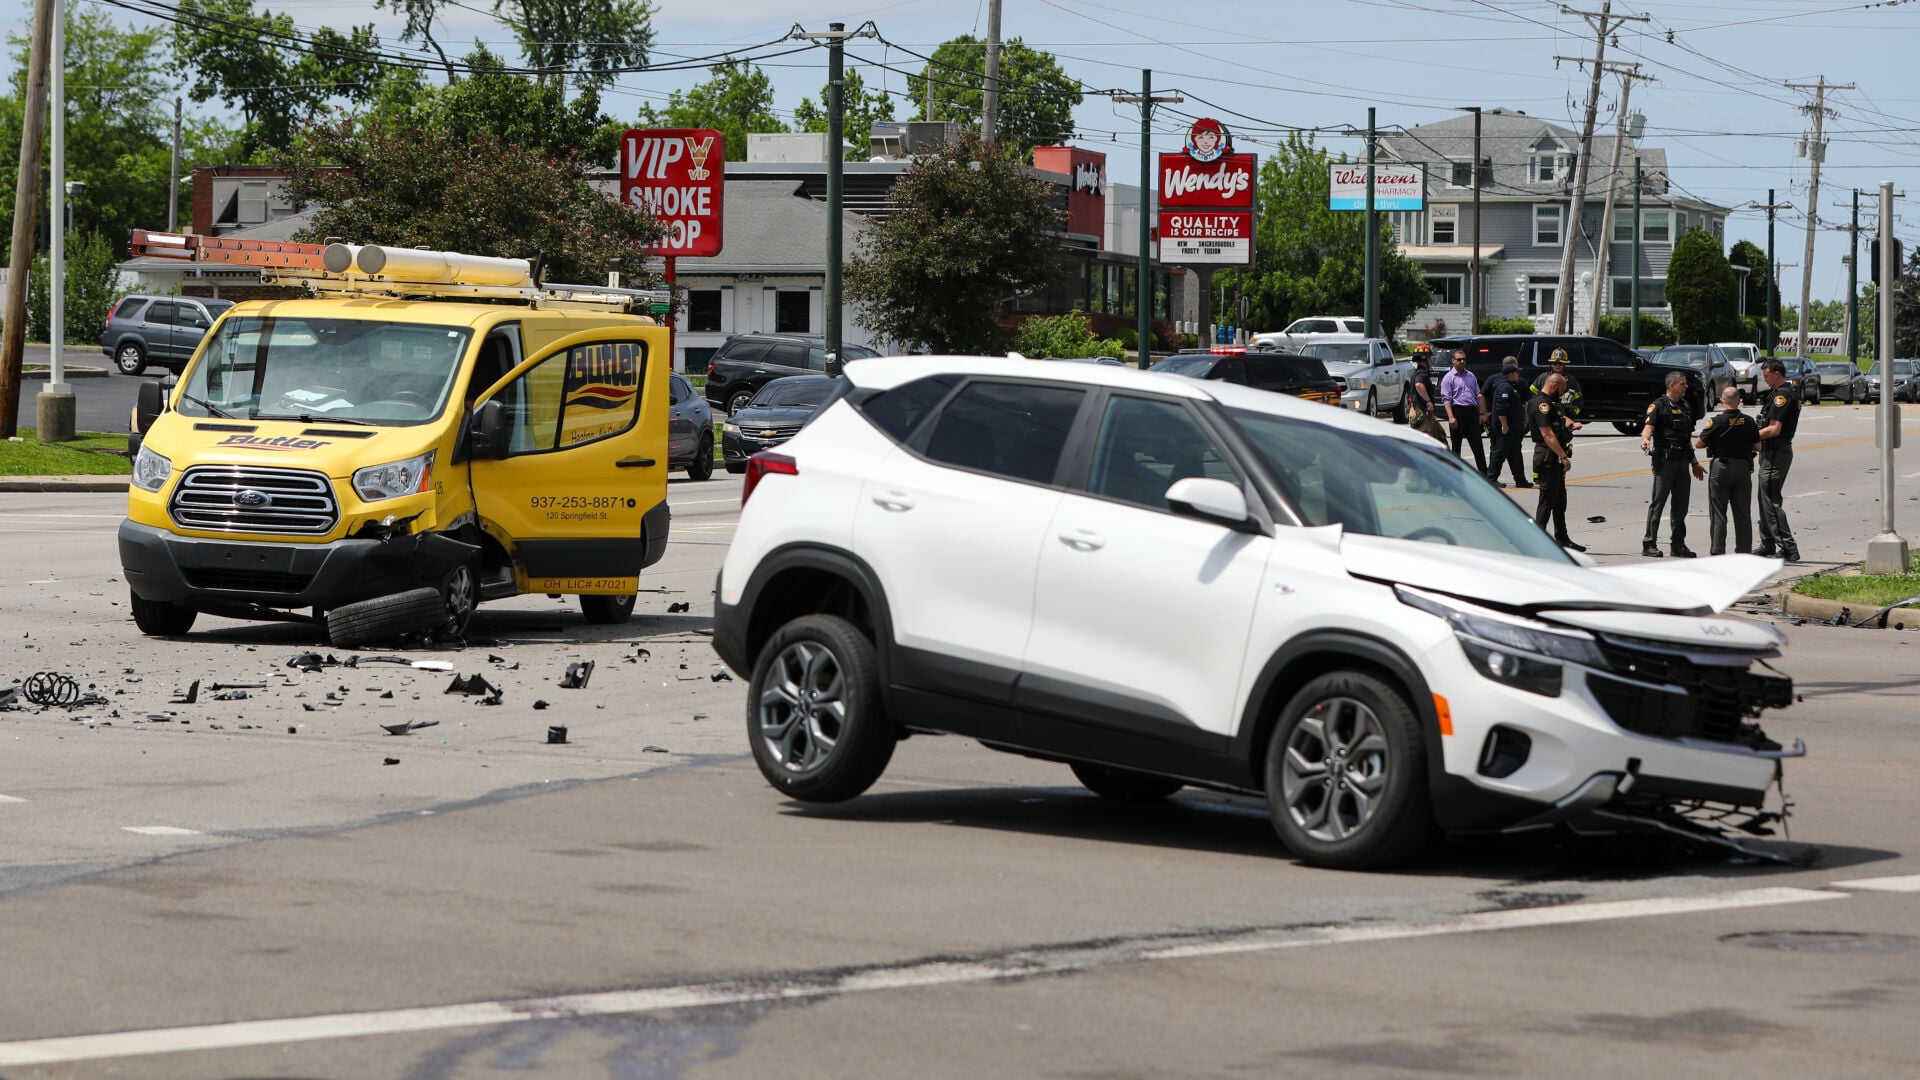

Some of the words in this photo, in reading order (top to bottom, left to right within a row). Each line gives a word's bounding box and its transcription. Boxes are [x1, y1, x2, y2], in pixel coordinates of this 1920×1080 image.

[627, 138, 684, 179] VIP
[688, 169, 710, 180] VIP
[1164, 162, 1249, 199] Wendy's
[1335, 169, 1418, 184] Walreens
[629, 186, 711, 216] SMOKE
[1381, 200, 1399, 208] thru
[1171, 216, 1240, 228] QUALITY
[1794, 337, 1839, 347] SATION
[217, 434, 333, 449] Butler
[530, 496, 625, 508] 937-253-8871
[546, 512, 559, 520] 120
[560, 511, 598, 521] Springfield
[544, 579, 561, 589] OH
[567, 579, 592, 589] LIC#
[595, 580, 626, 589] 47021
